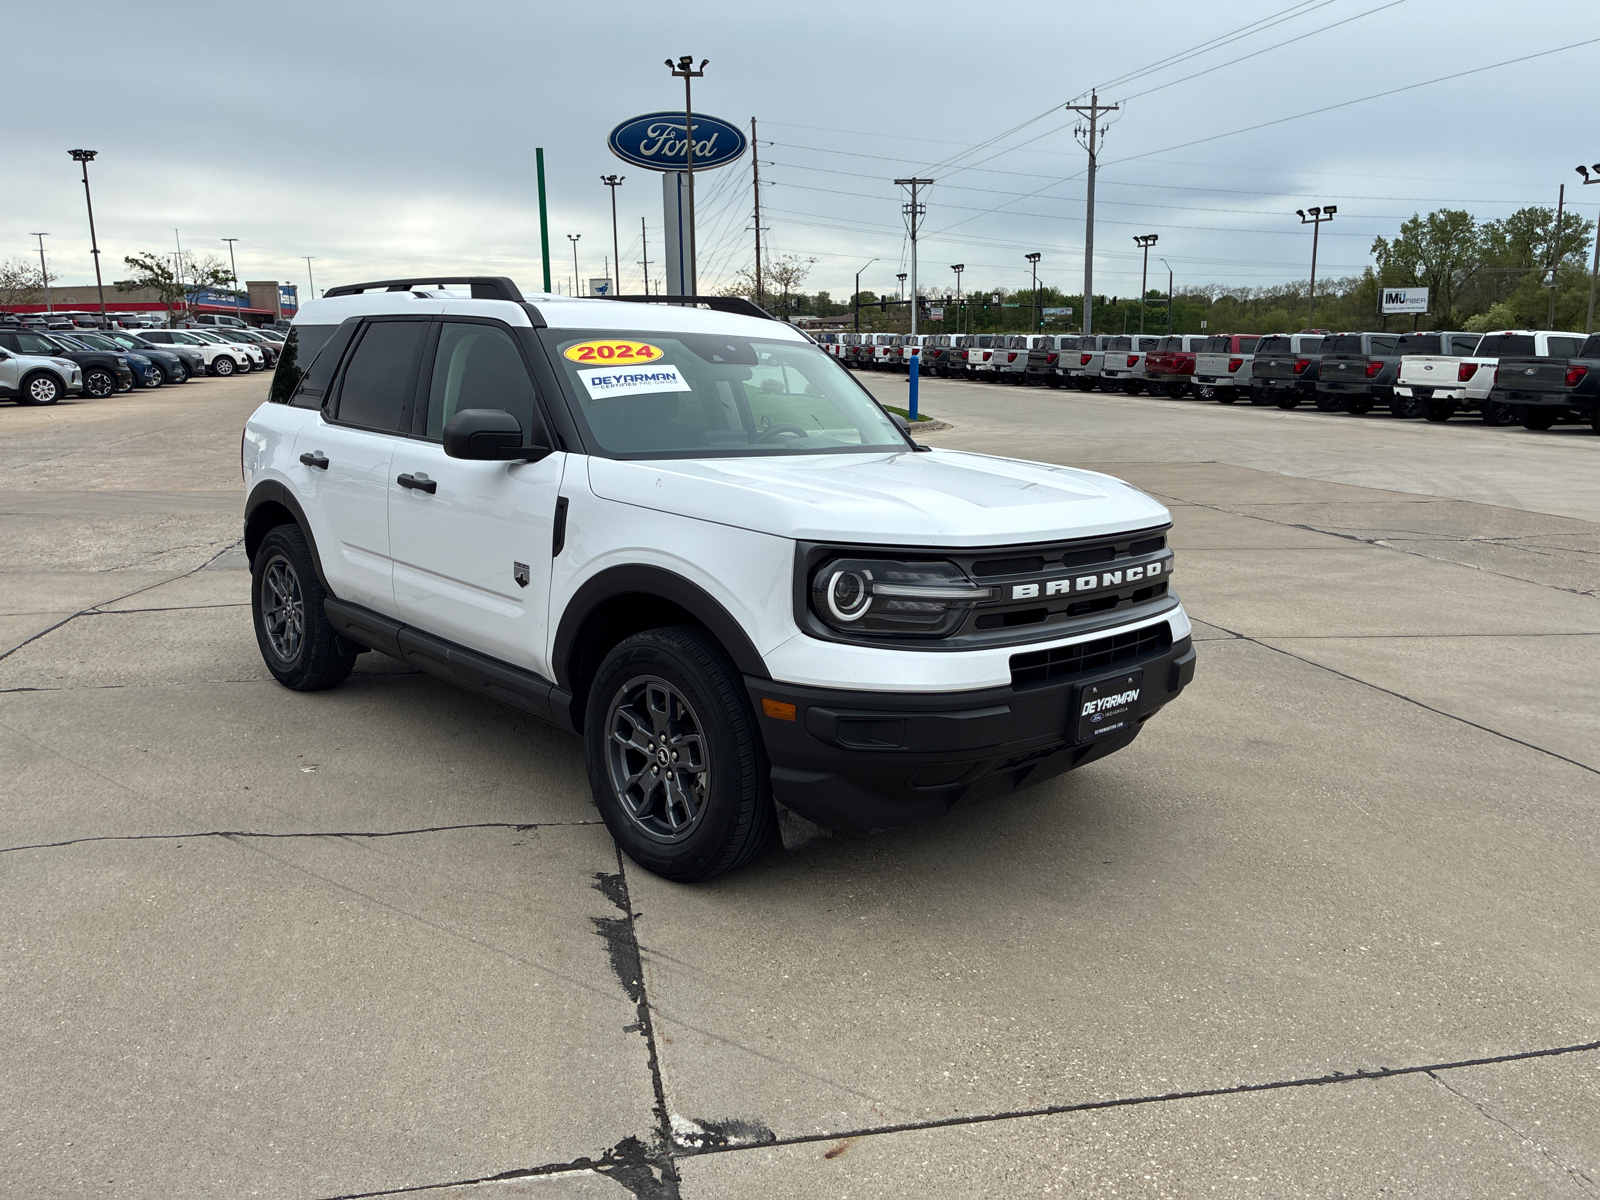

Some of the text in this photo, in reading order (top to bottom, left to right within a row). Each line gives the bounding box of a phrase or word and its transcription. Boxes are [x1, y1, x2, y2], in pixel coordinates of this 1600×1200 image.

[639, 122, 719, 157] Ford
[1385, 292, 1406, 304] IMU
[577, 345, 655, 361] 2024
[591, 372, 677, 387] DEYARMAN
[600, 379, 679, 390] CERTIFIED PRE-OWNED
[1012, 562, 1162, 599] BRONCO
[1081, 688, 1140, 717] DEYARMAN
[1105, 706, 1128, 718] INDIANOLA
